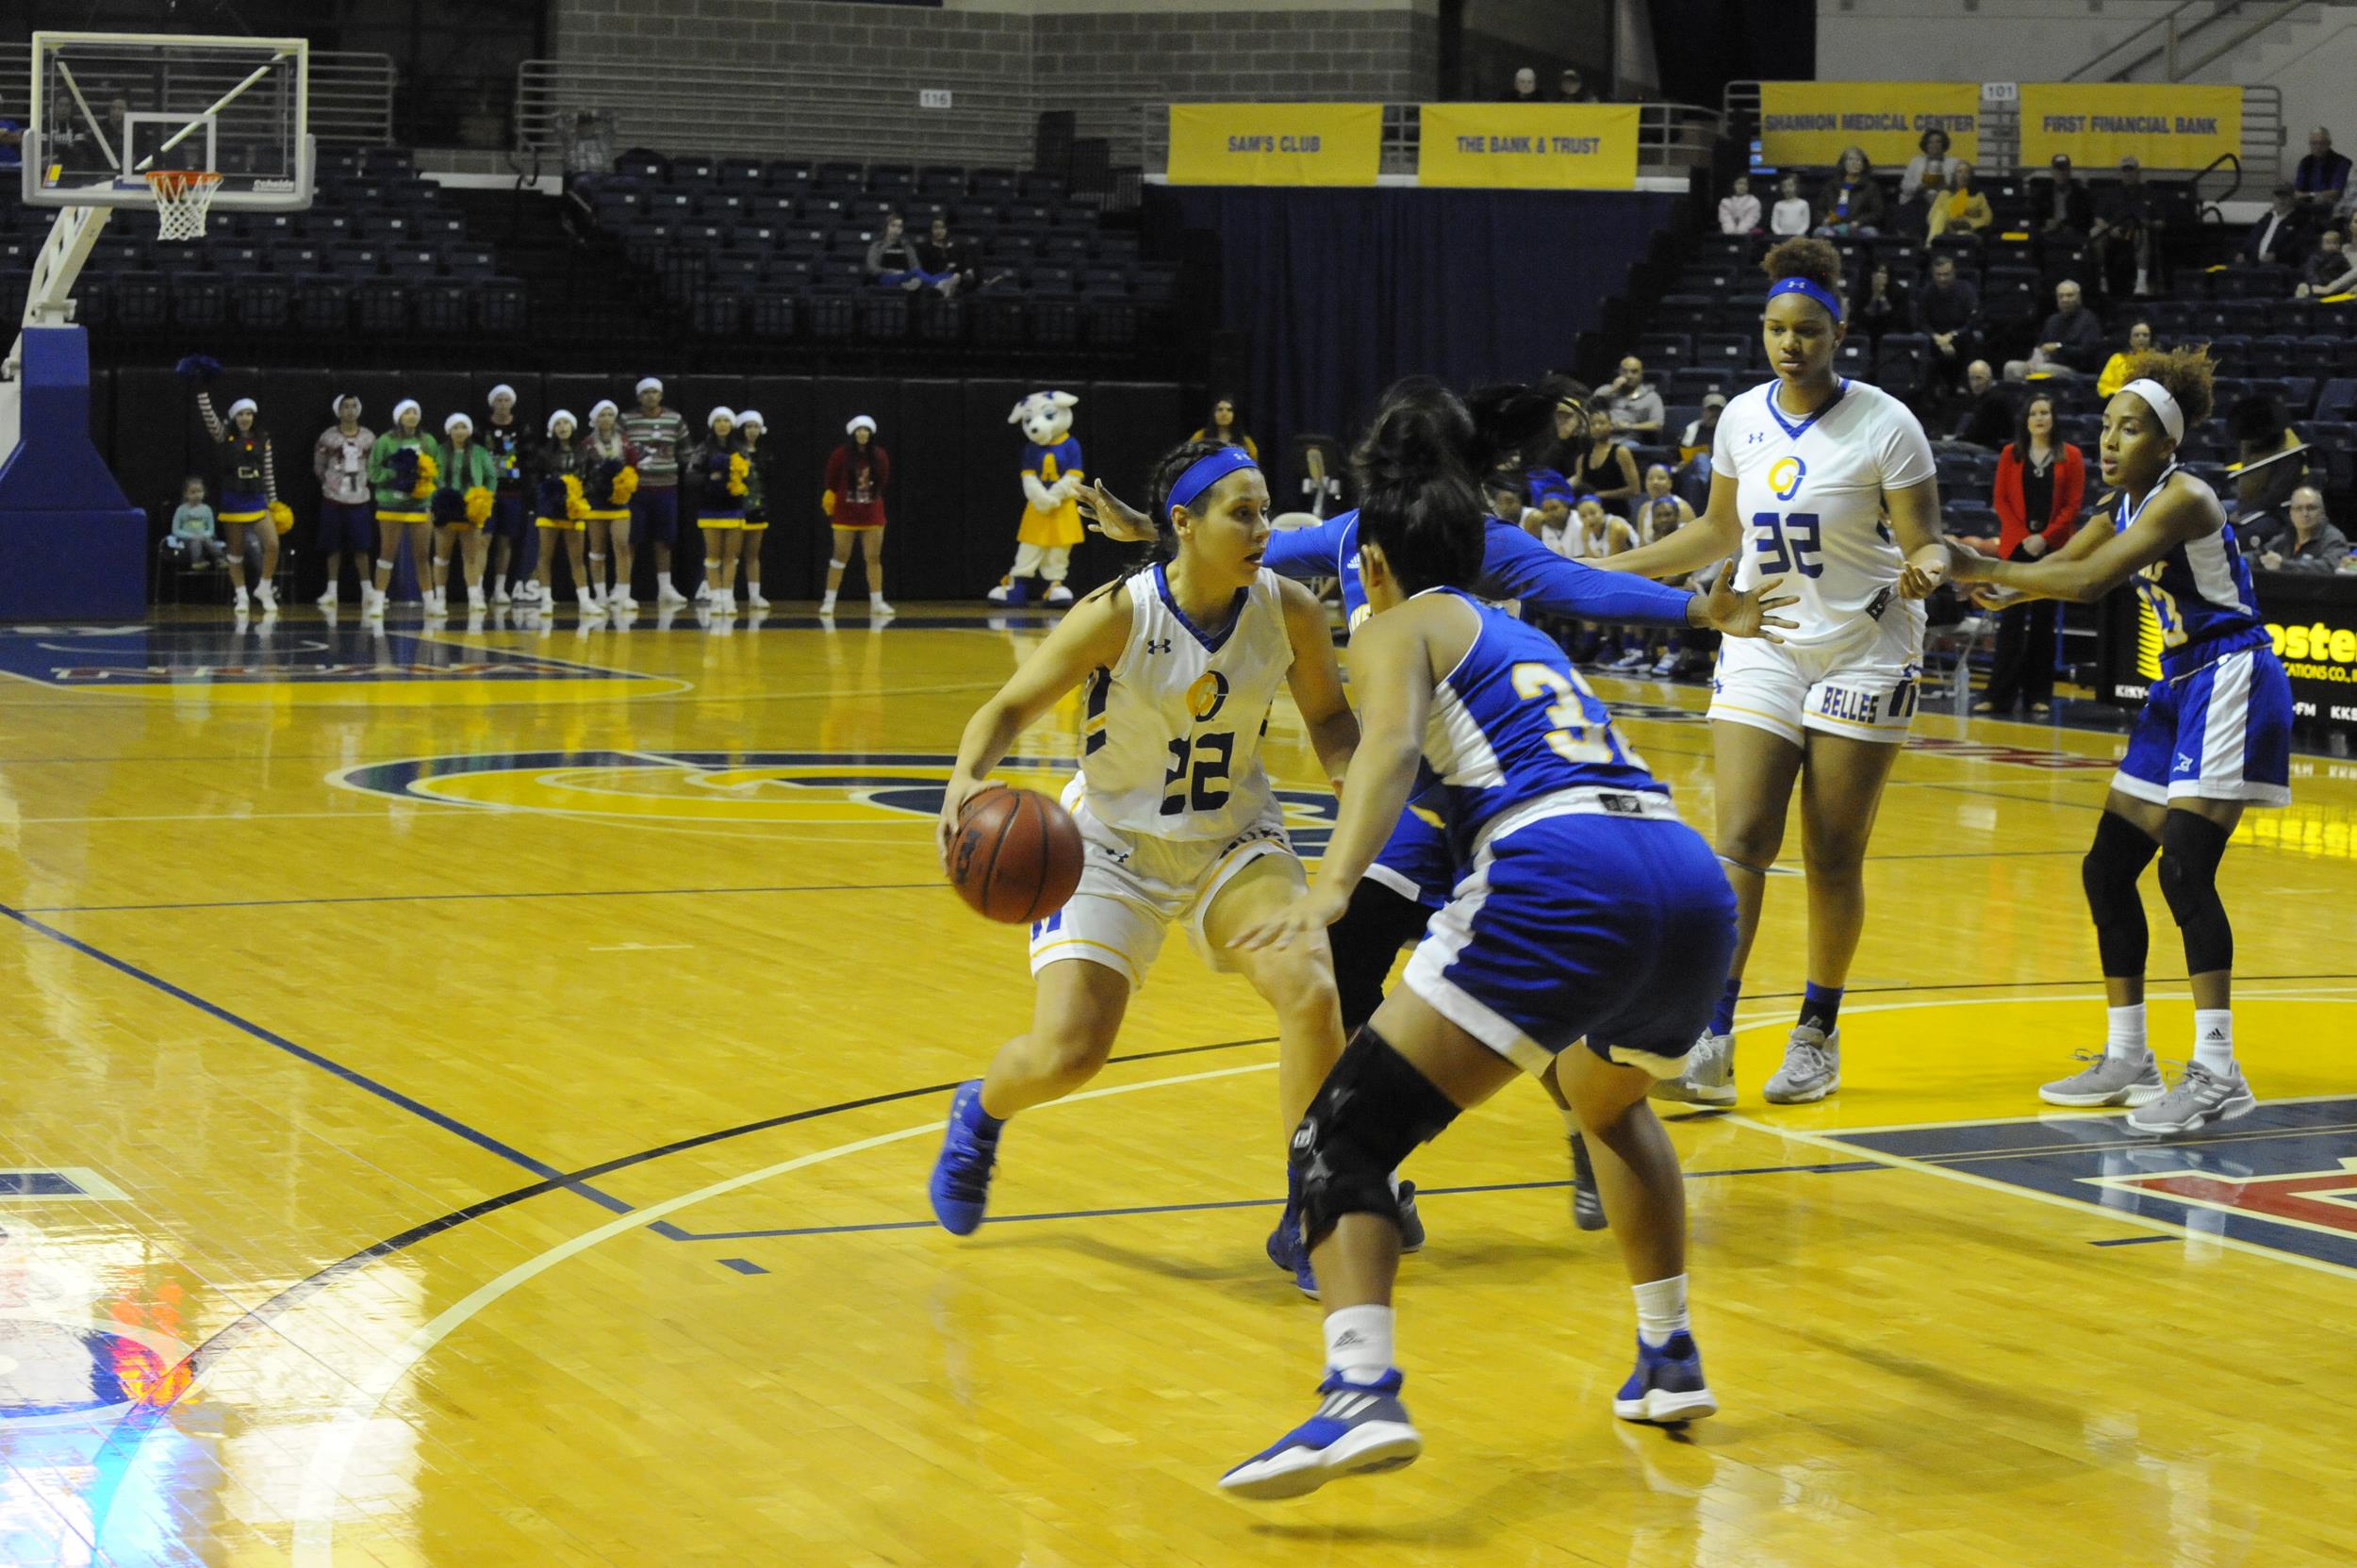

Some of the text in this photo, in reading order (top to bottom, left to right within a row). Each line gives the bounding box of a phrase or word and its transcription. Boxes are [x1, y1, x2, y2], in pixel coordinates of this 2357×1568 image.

[924, 93, 948, 106] 116
[1988, 86, 2014, 98] 101
[1765, 114, 1974, 132] SHANNON MEDICAL CENTER
[2043, 115, 2217, 135] FIRST FINANCIAL BANK
[1228, 136, 1321, 153] SAM'S CLUB
[1457, 136, 1600, 155] THE BANK & TRUST
[1752, 513, 1823, 578] 32
[2264, 622, 2357, 663] oste
[1821, 685, 1879, 724] BELLES
[1160, 732, 1235, 816] 22
